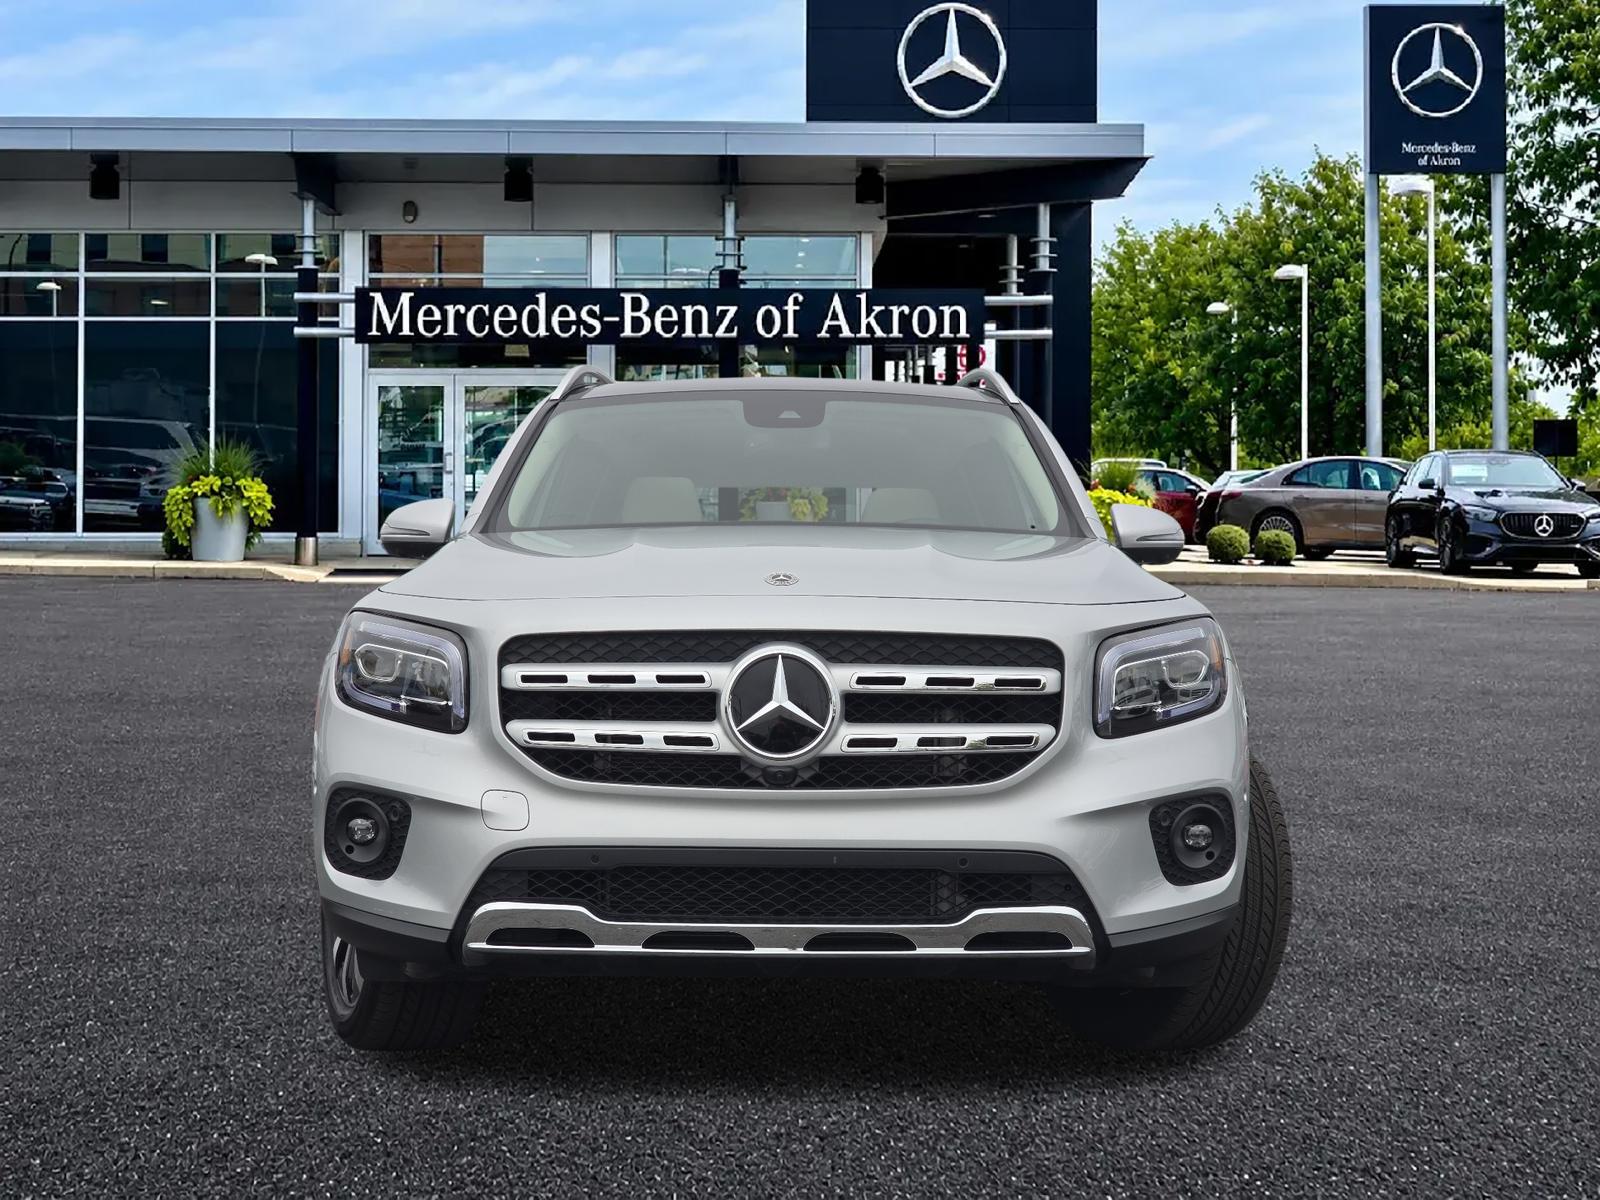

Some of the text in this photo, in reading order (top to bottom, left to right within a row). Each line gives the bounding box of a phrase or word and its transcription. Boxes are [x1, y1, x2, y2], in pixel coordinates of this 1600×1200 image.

[1401, 141, 1476, 153] Mercedes-Benz
[1418, 155, 1461, 165] of Akron
[367, 291, 970, 339] Mercedes-Benz of Akron
